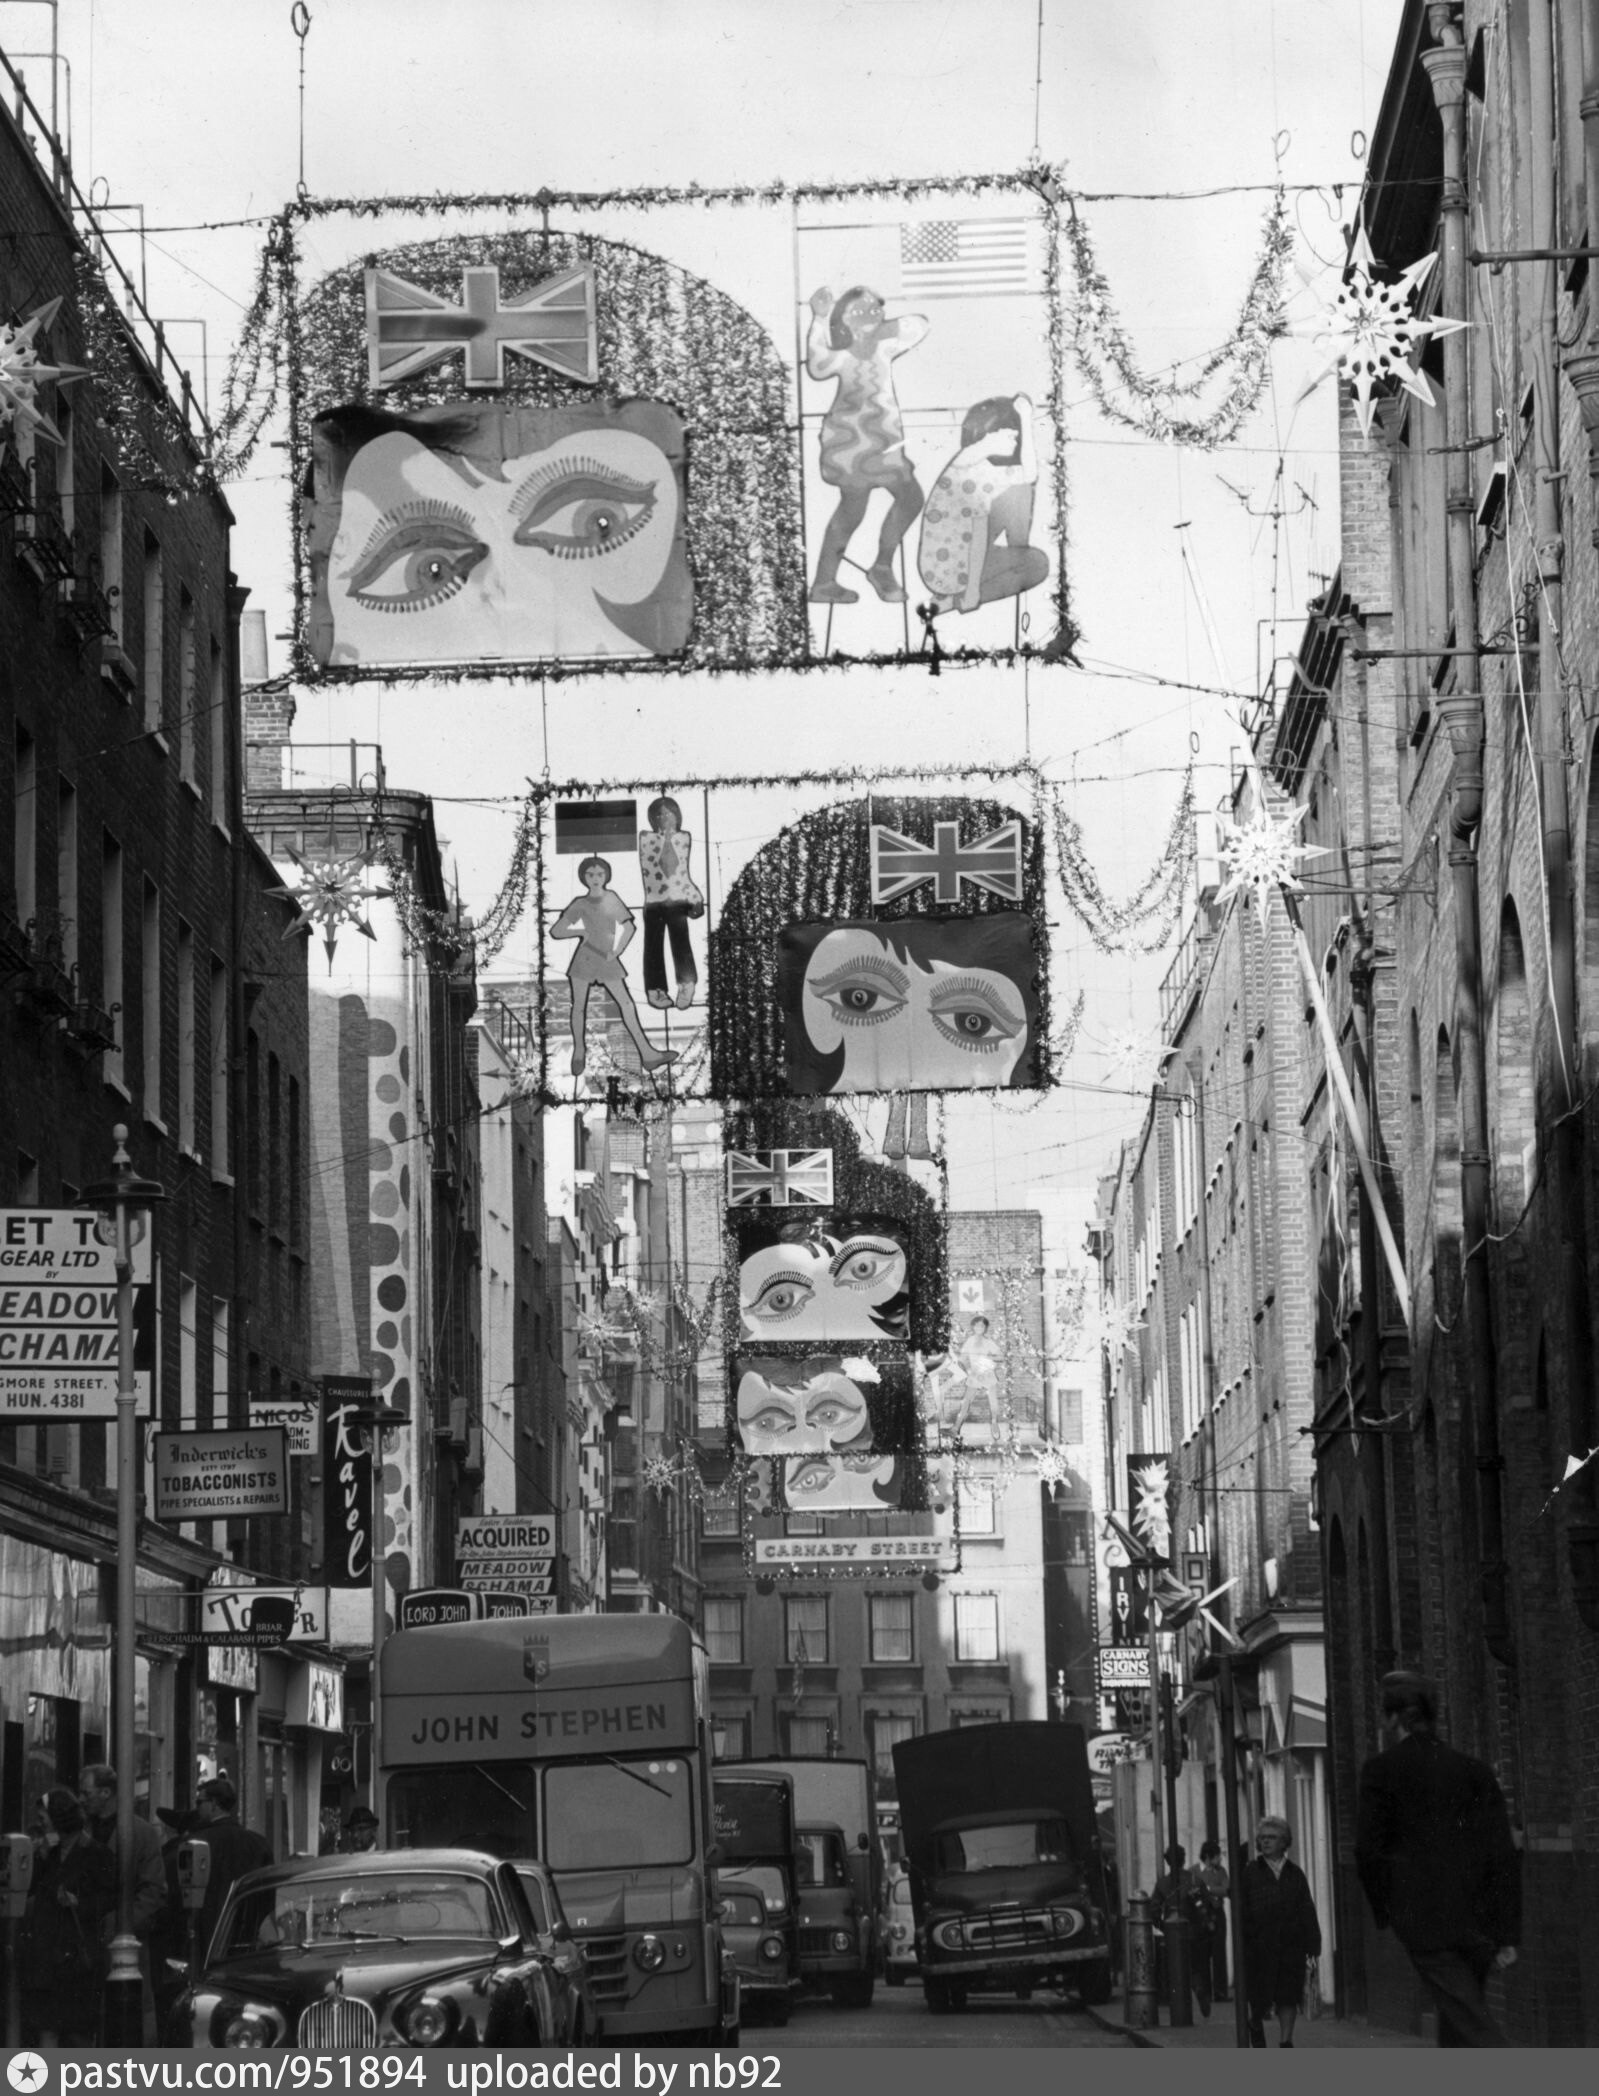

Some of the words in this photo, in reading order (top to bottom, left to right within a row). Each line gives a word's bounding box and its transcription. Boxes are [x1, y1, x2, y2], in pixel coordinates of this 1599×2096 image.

[0, 1217, 53, 1245] ET
[0, 1250, 54, 1266] GEAR
[61, 1250, 100, 1267] LTD
[45, 1271, 59, 1279] BY
[50, 1393, 84, 1409] 4381
[169, 1441, 268, 1464] Inderwick's
[162, 1472, 277, 1492] TOBACCONISTS
[160, 1498, 180, 1509] PIPE
[182, 1495, 235, 1508] SPECIALISTS
[243, 1493, 280, 1505] REPAIRS
[461, 1526, 550, 1549] ACQUIRED
[764, 1543, 858, 1558] CARNABY
[870, 1542, 943, 1556] STREET
[464, 1561, 546, 1575] MEADOW
[407, 1606, 437, 1623] LORD
[439, 1605, 467, 1621] JOHN
[491, 1604, 523, 1619] JOHN
[257, 1634, 281, 1644] PIPES
[1103, 1651, 1148, 1660] CARNABY
[1103, 1660, 1149, 1676] SIGNS
[411, 1714, 499, 1744] JOHN
[520, 1703, 667, 1740] STEPHEN
